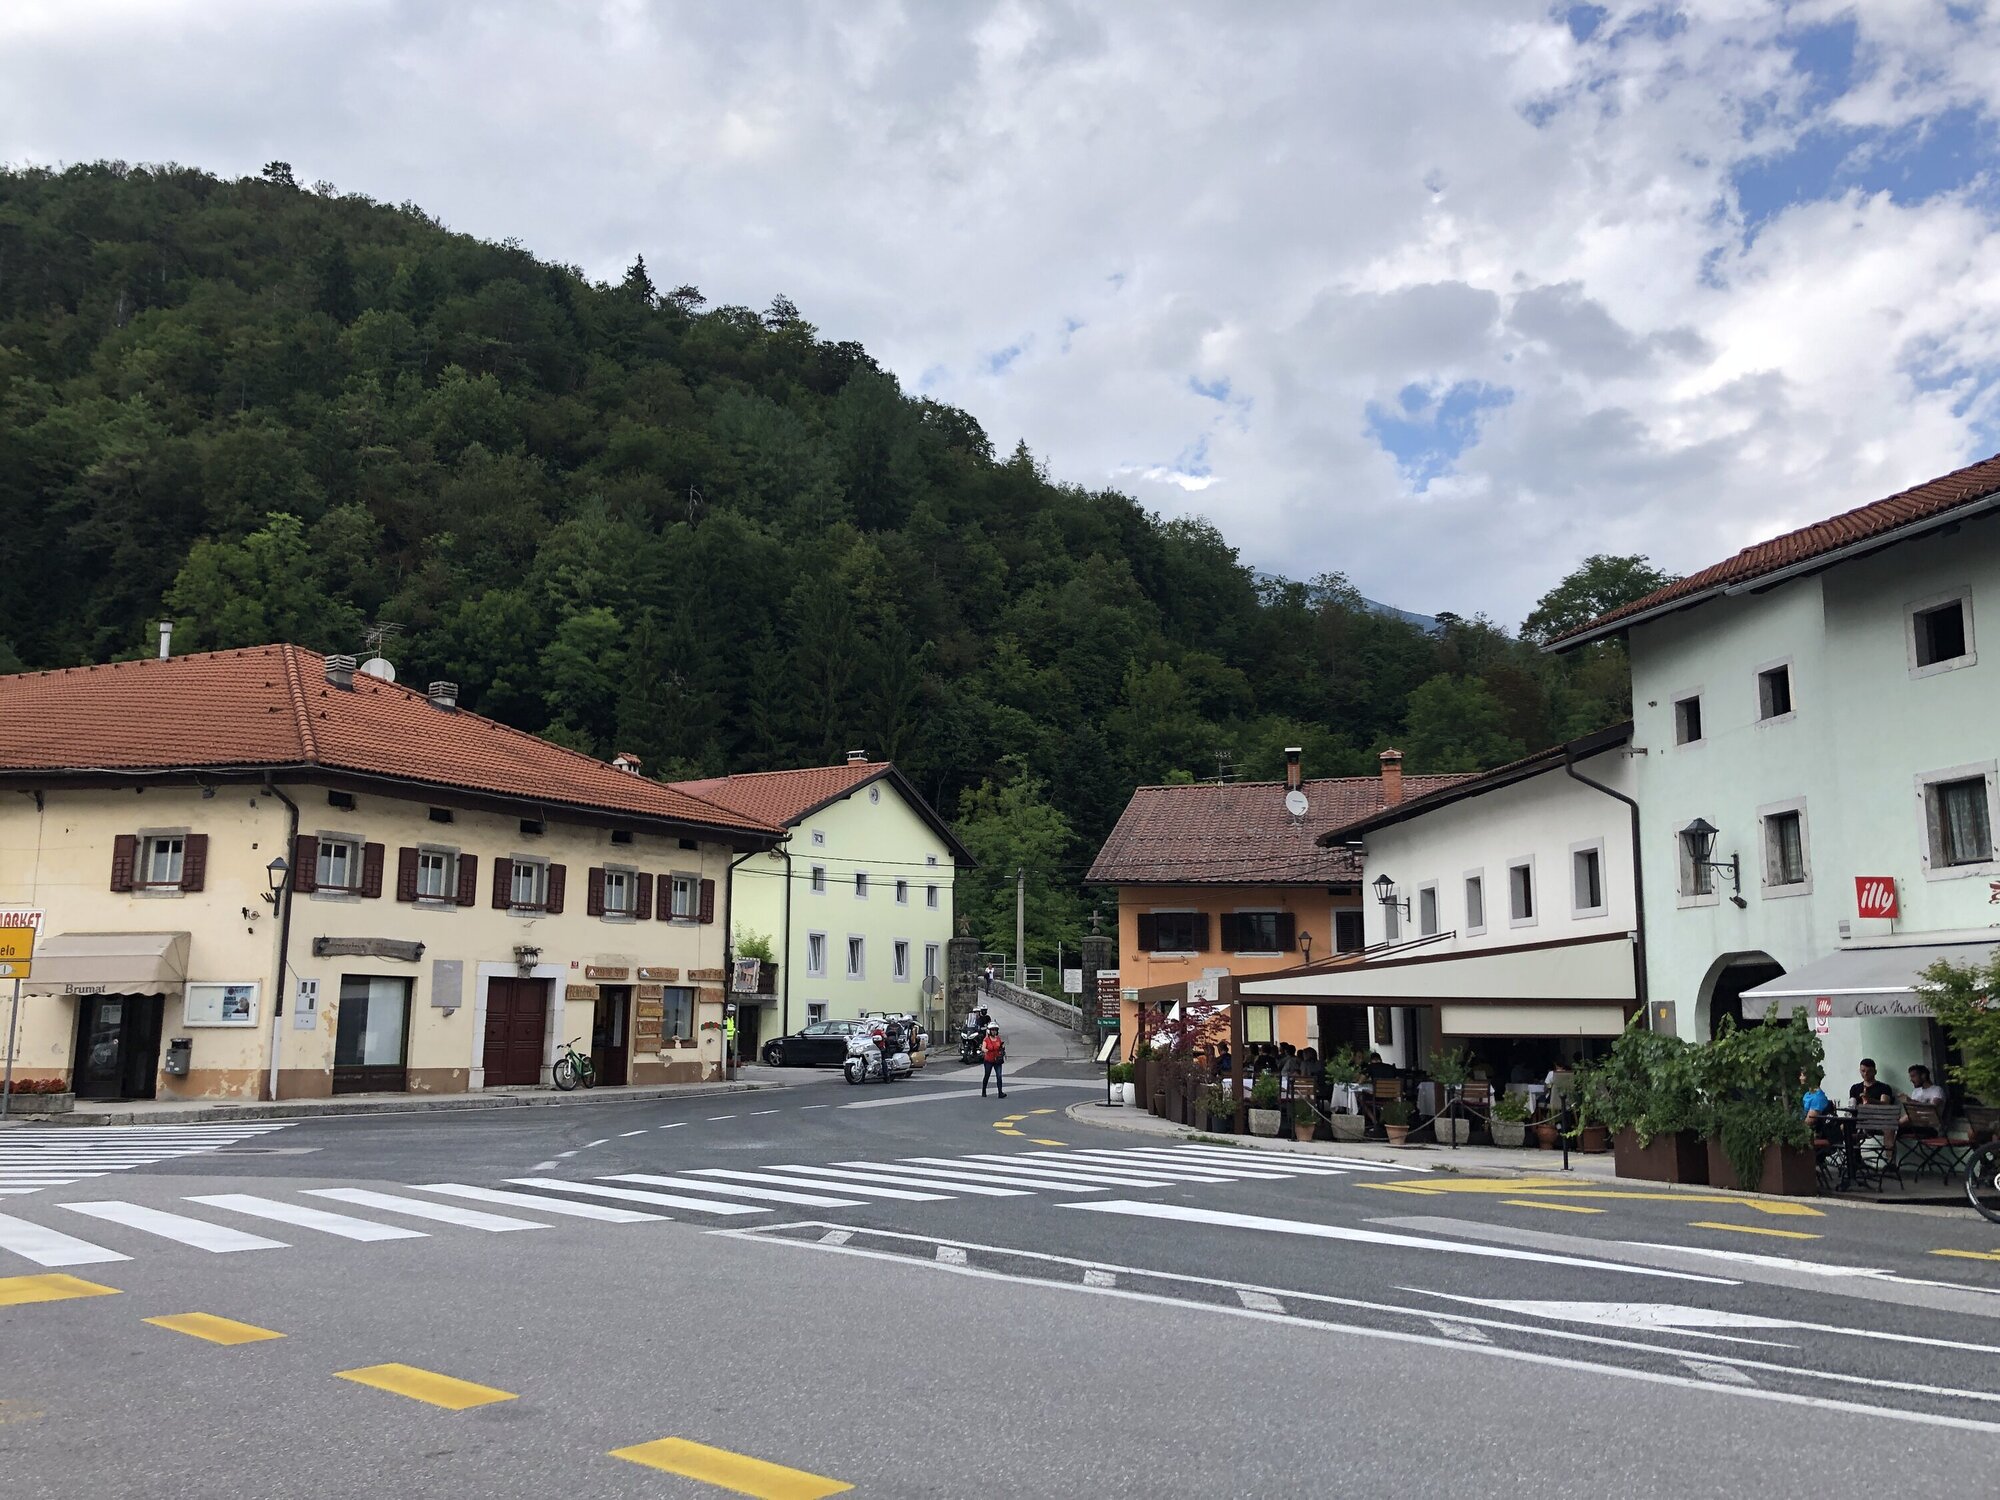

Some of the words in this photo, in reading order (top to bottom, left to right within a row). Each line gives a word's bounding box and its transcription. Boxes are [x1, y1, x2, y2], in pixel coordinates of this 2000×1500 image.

[1860, 882, 1894, 915] illy
[0, 912, 41, 929] ARKET
[64, 983, 106, 995] Brumat
[1817, 1000, 1832, 1015] illy
